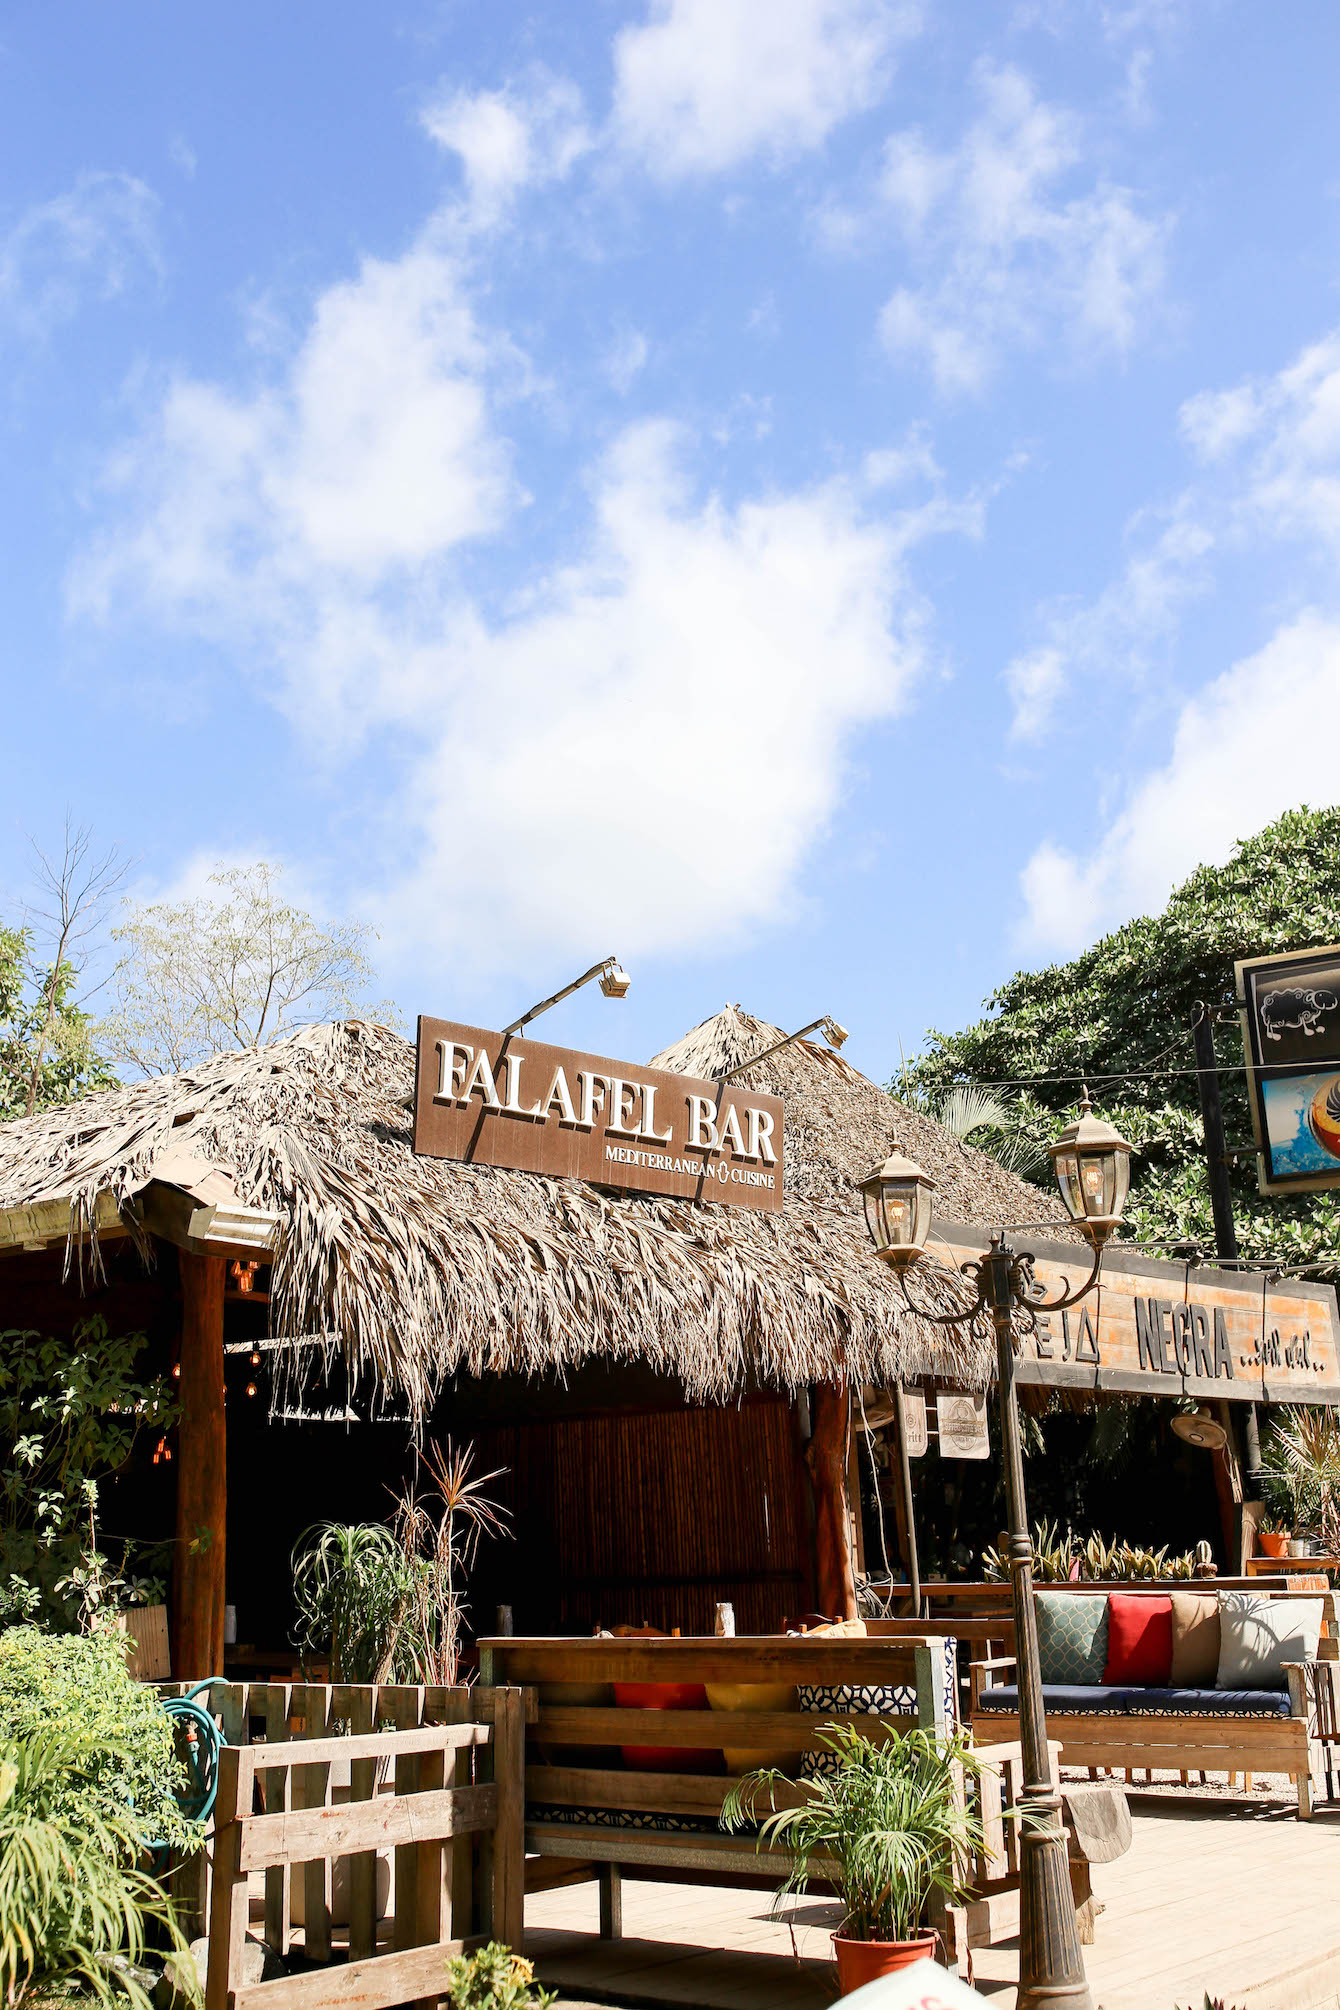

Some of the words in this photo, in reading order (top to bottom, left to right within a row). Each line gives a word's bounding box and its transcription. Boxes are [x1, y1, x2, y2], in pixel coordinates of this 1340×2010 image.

[437, 1039, 673, 1142] FALAFEL
[687, 1094, 779, 1162] BAR
[605, 1145, 716, 1179] MEDITERRANEAN
[730, 1168, 775, 1189] CUISINE
[1134, 1296, 1234, 1379] NEGRA
